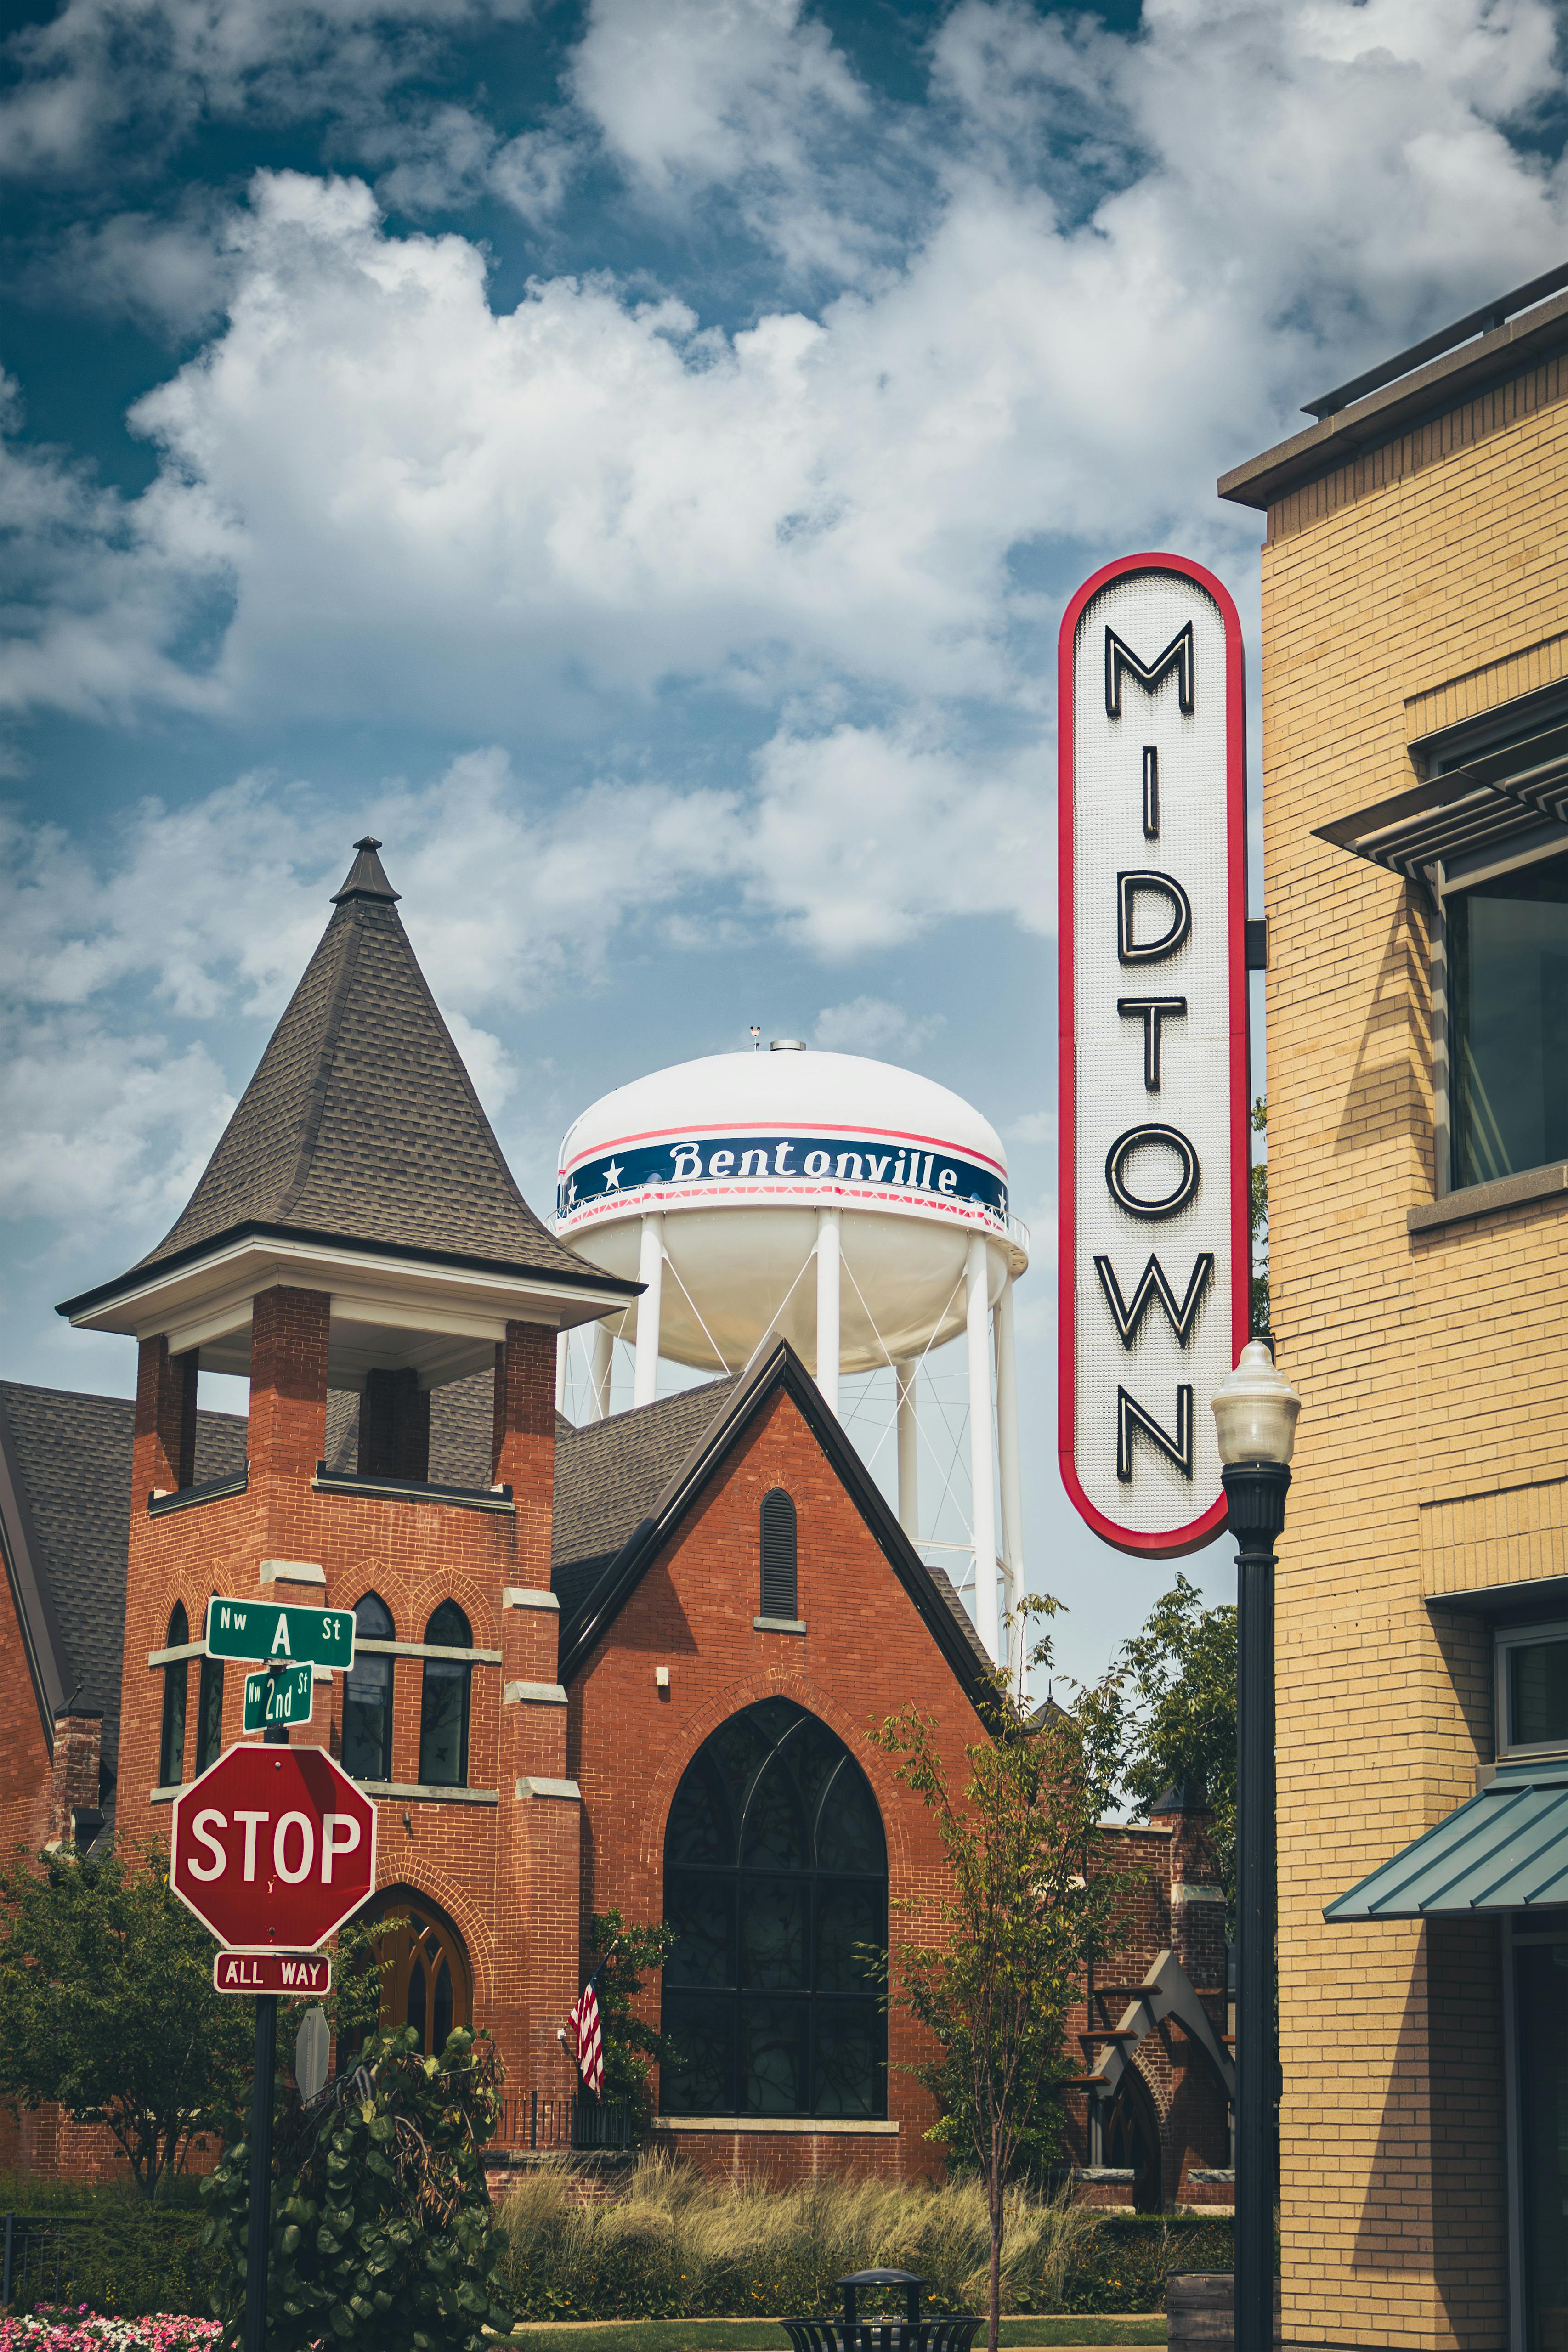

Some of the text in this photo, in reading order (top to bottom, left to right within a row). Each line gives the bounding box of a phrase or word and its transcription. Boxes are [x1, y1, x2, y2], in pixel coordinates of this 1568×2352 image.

[1093, 619, 1214, 1481] MIDTOWN
[669, 1141, 957, 1193] Bentonville
[271, 1613, 291, 1656] A
[322, 1617, 340, 1640] St
[266, 1678, 291, 1720] 2nd
[298, 1672, 307, 1695] St
[187, 1809, 361, 1884] STOP
[225, 1961, 321, 1986] ALL WAY
